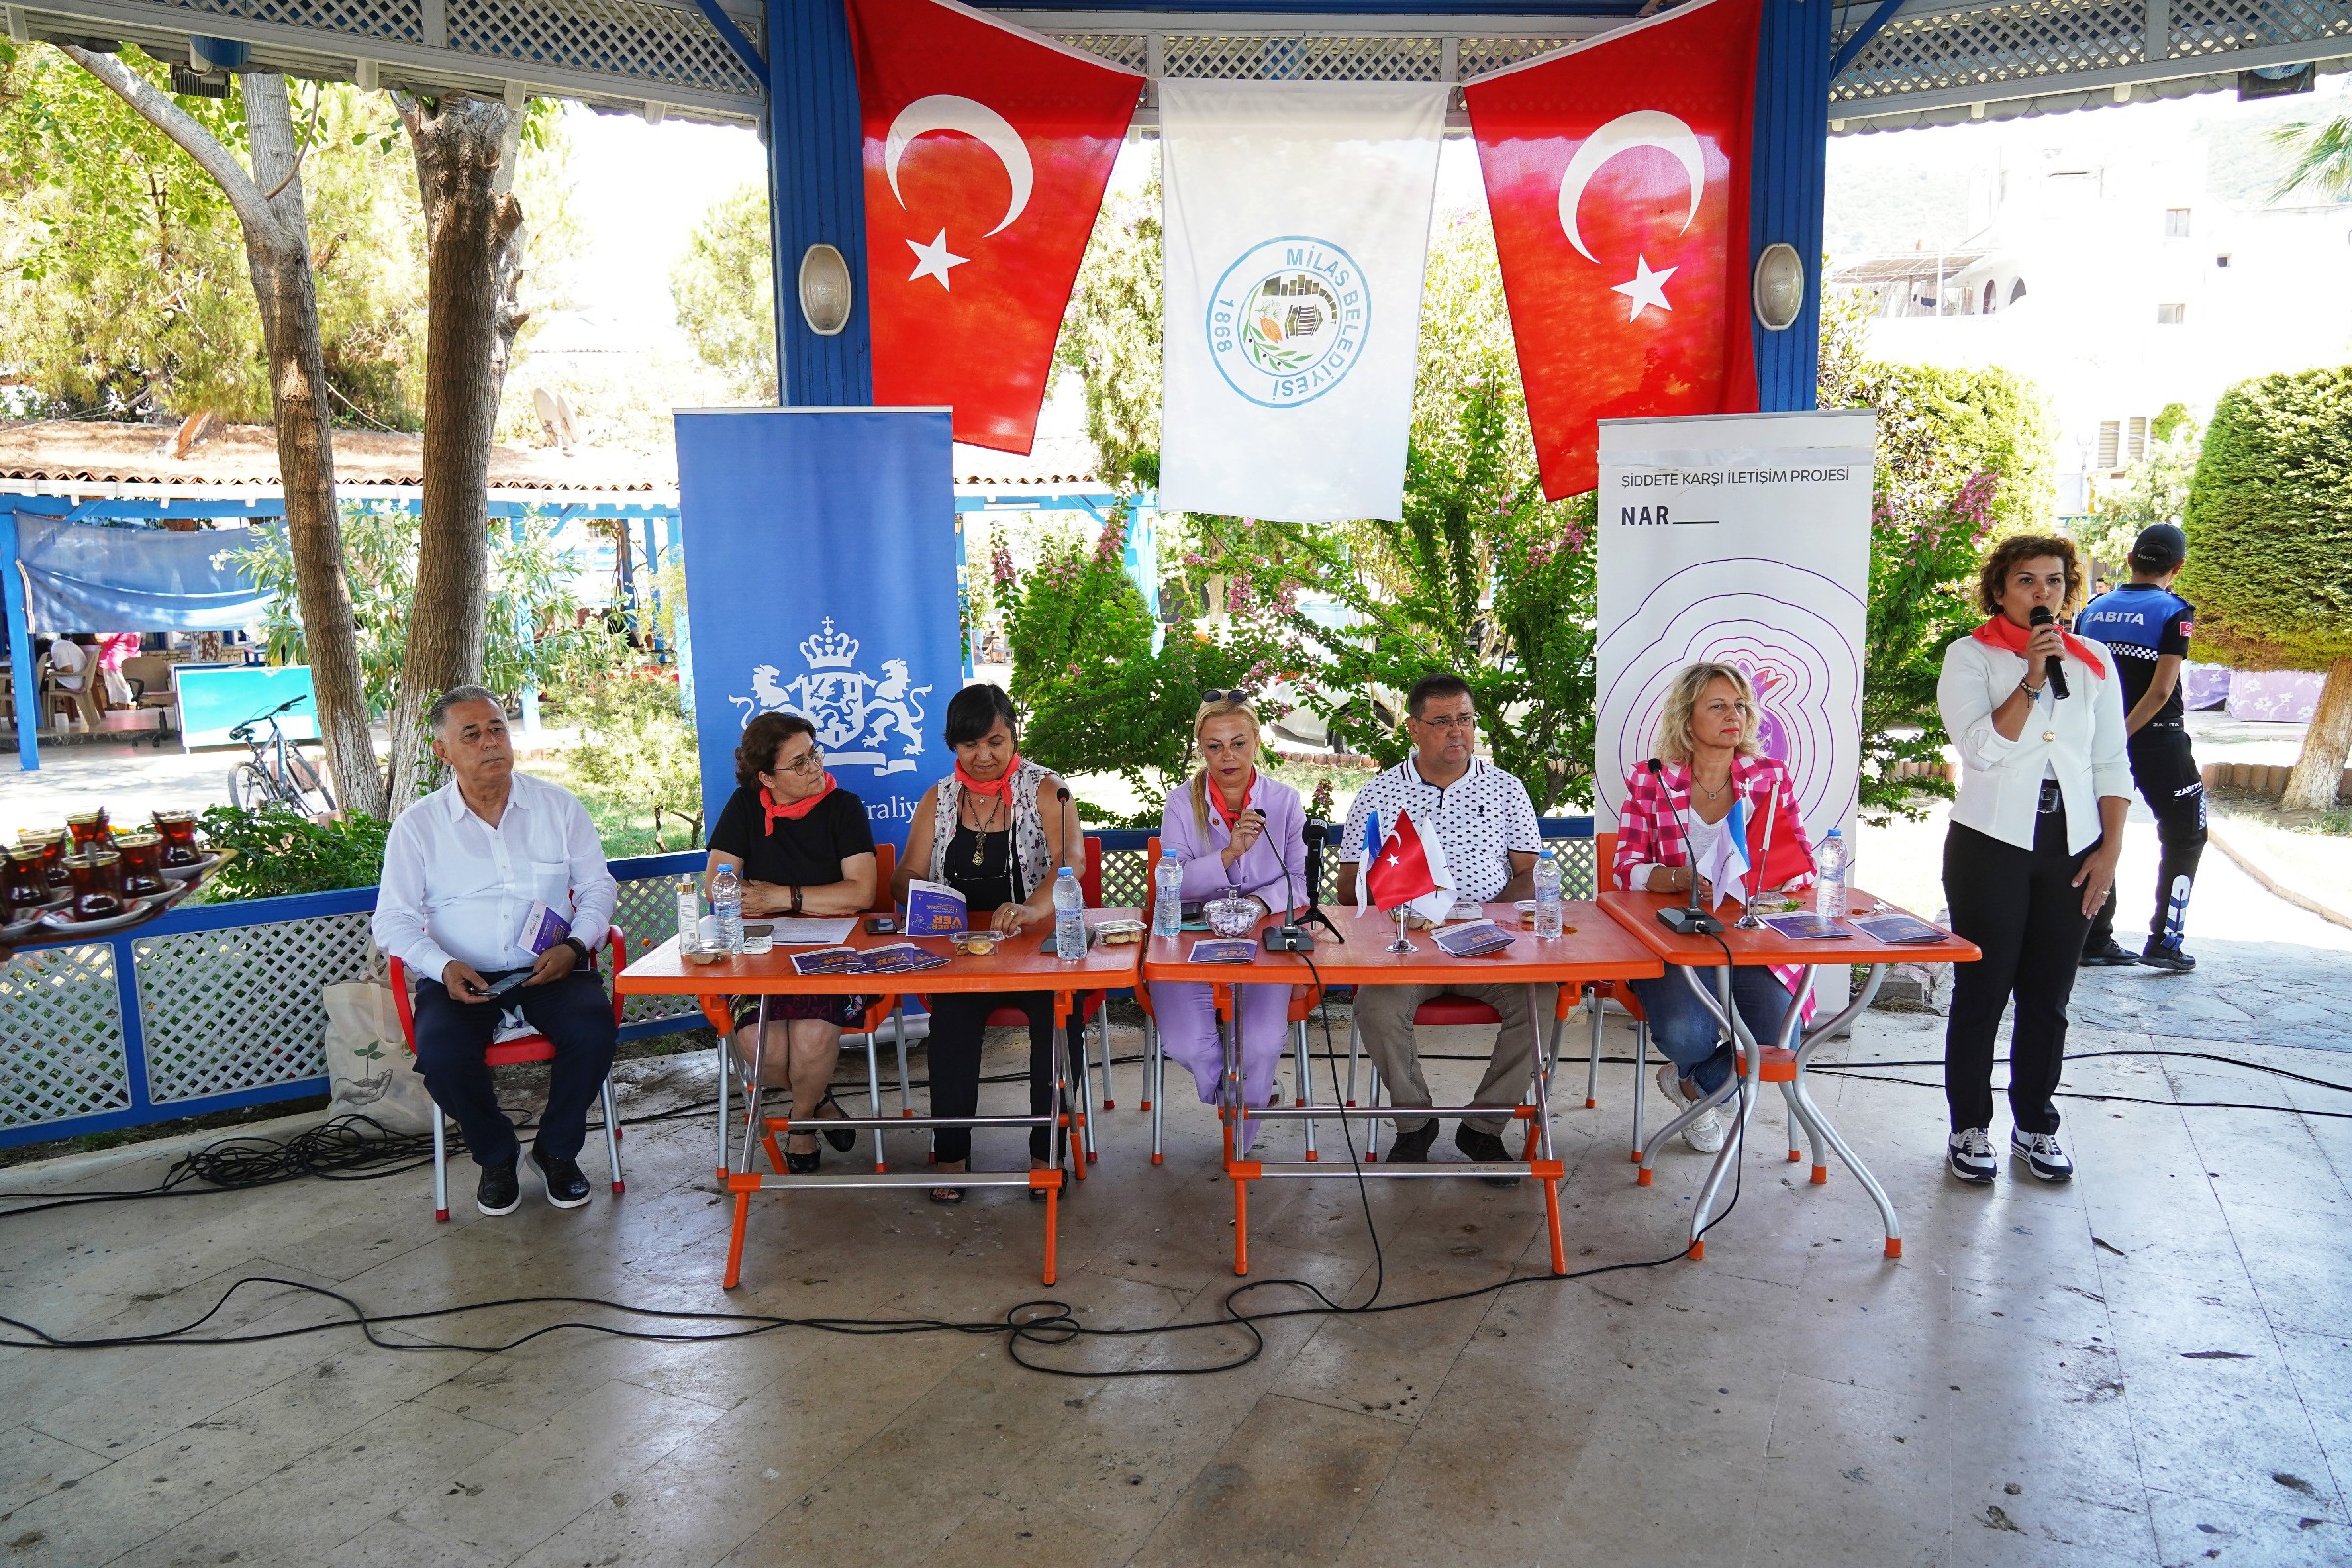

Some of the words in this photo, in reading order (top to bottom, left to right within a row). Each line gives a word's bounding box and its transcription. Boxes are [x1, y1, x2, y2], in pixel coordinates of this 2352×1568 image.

[1286, 245, 1350, 287] MİLAS
[1214, 298, 1234, 353] 1868
[1272, 290, 1361, 401] BELEDİYESİ
[1621, 473, 1679, 489] ŞİDDETE
[1682, 472, 1723, 487] KARŞI
[1728, 468, 1788, 485] İLETİŞİM
[1790, 466, 1850, 483] PROJESİ
[1621, 505, 1669, 526] NAR
[2085, 611, 2145, 626] ZABITA
[861, 795, 920, 824] raliy
[932, 914, 963, 928] VER
